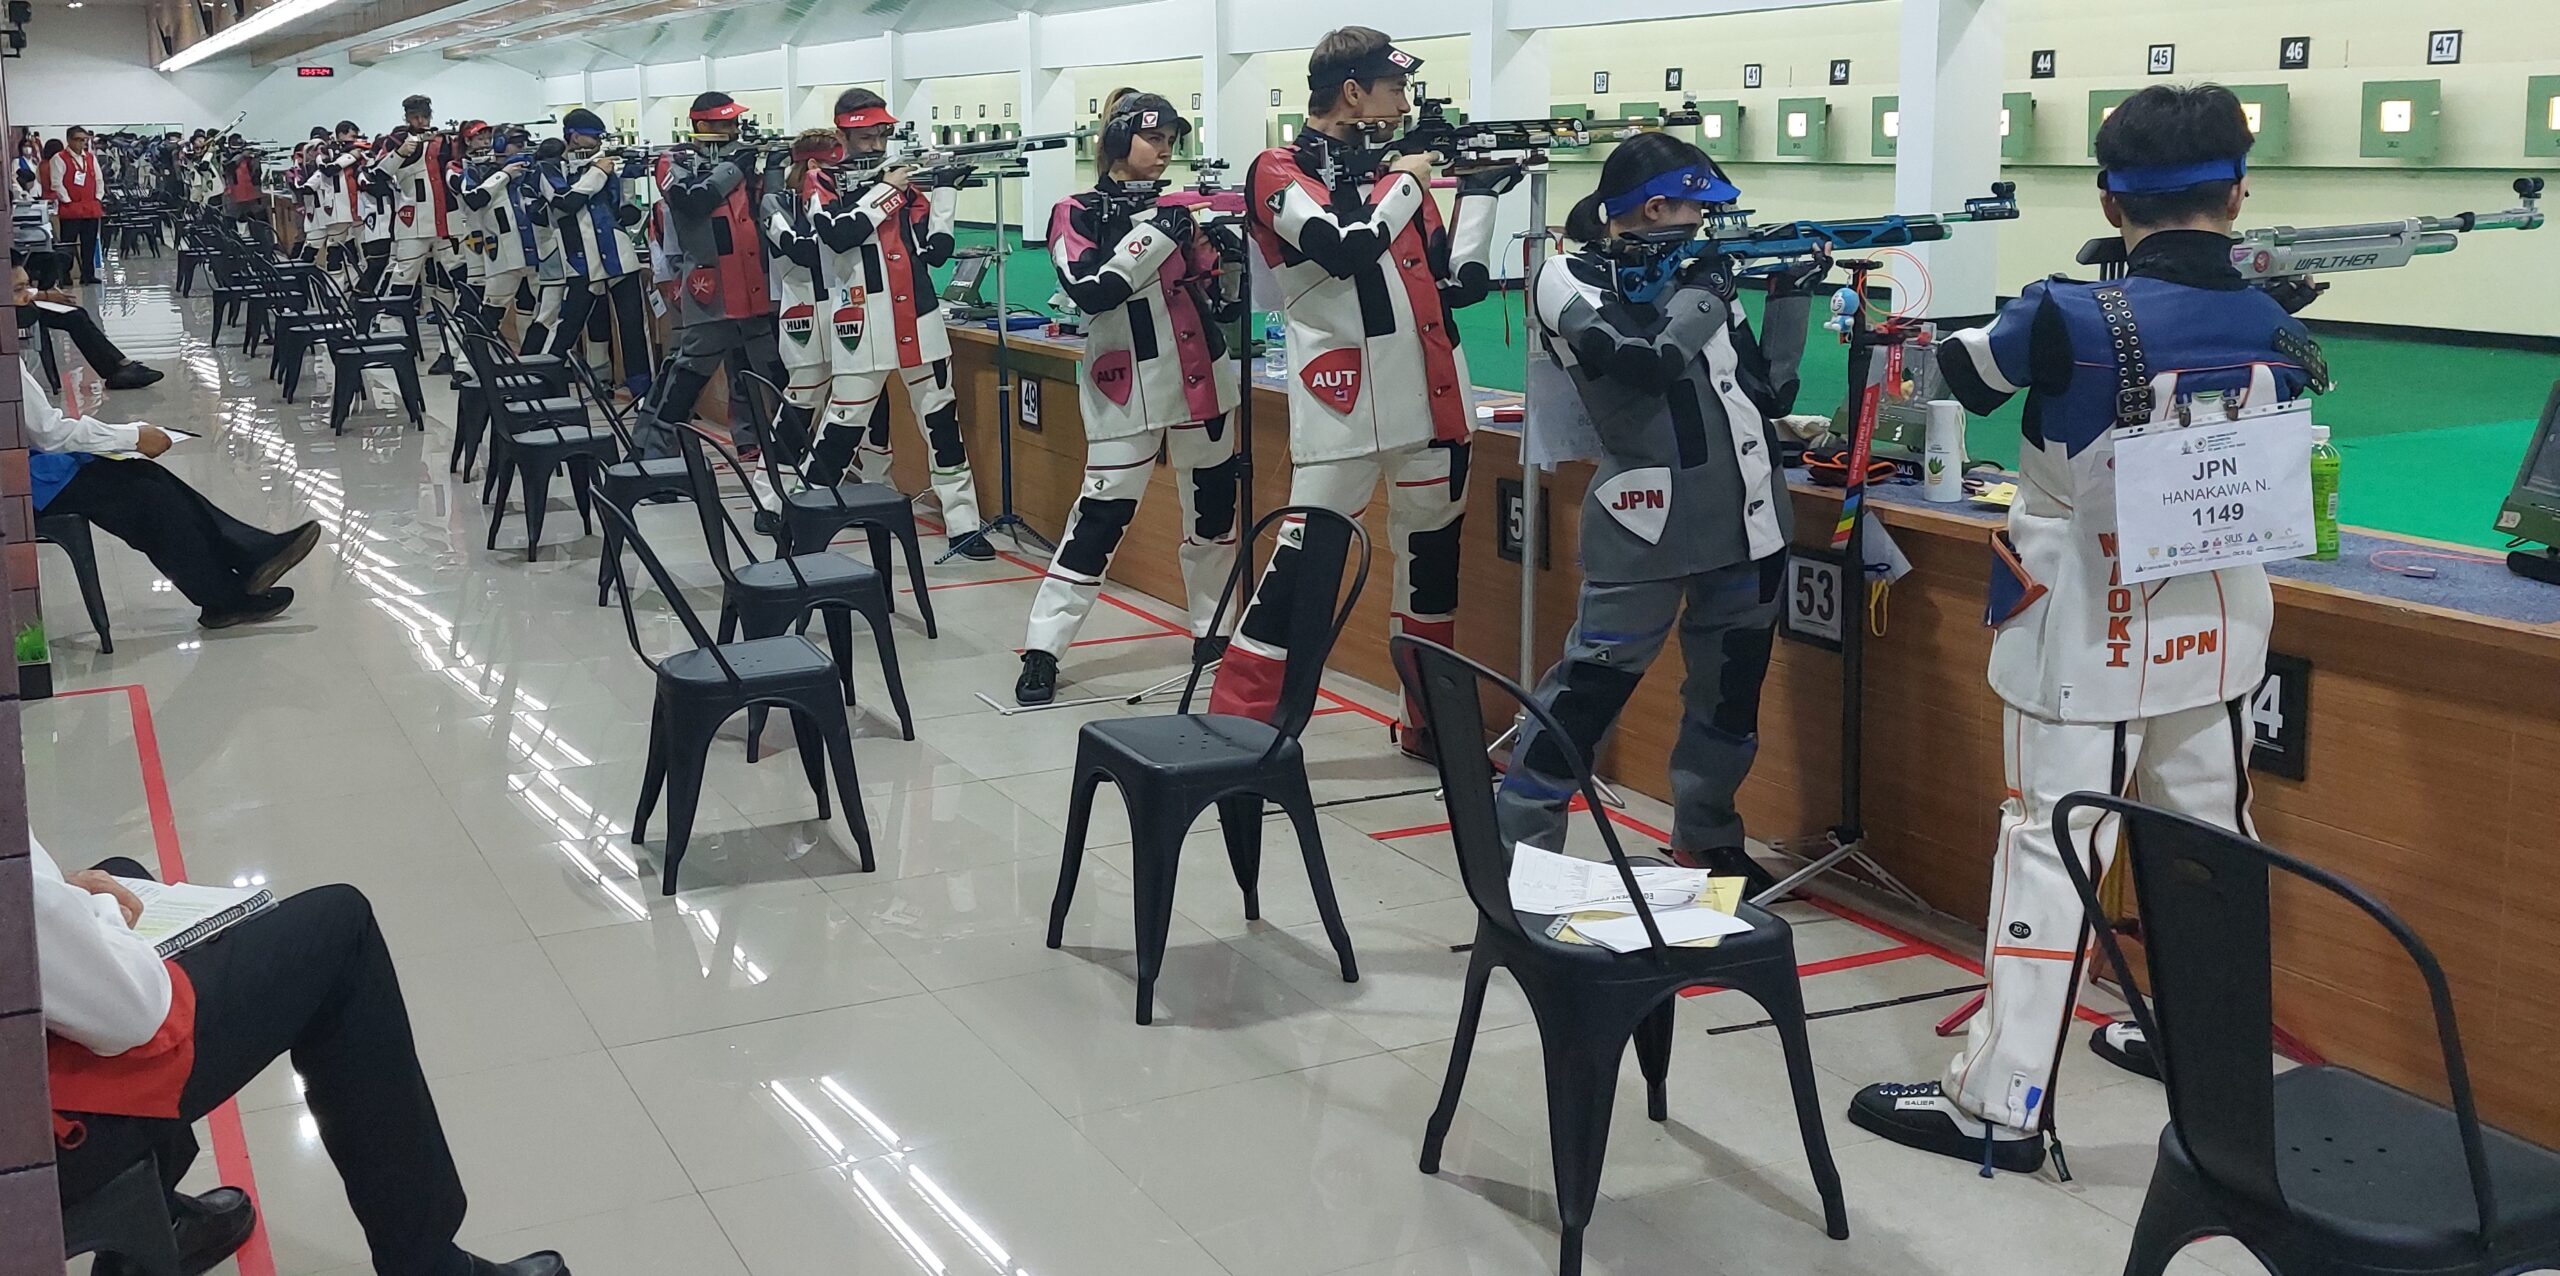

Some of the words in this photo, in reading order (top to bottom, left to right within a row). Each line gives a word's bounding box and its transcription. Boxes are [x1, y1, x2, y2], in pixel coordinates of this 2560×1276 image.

[2285, 41, 2304, 60] 46
[2435, 36, 2454, 54] 47
[2036, 53, 2052, 72] 44
[2153, 49, 2168, 65] 45
[1668, 70, 1679, 86] 40
[1748, 67, 1758, 81] 41
[1834, 62, 1846, 78] 42
[1597, 74, 1606, 87] 39
[882, 193, 903, 213] ELEY
[2293, 252, 2379, 271] WALTHER
[786, 319, 810, 331] HUN
[835, 323, 859, 336] HUN
[1097, 367, 1127, 384] AUT
[1311, 370, 1358, 388] AUT
[1023, 382, 1037, 413] 49
[2191, 457, 2238, 481] JPN
[1611, 489, 1664, 511] JPN
[2162, 481, 2252, 506] HANAKAWA
[2255, 478, 2271, 492] N.
[2192, 502, 2245, 527] 1149
[2224, 533, 2243, 544] SIUS
[1796, 565, 1835, 621] 53
[2152, 628, 2218, 665] JPN
